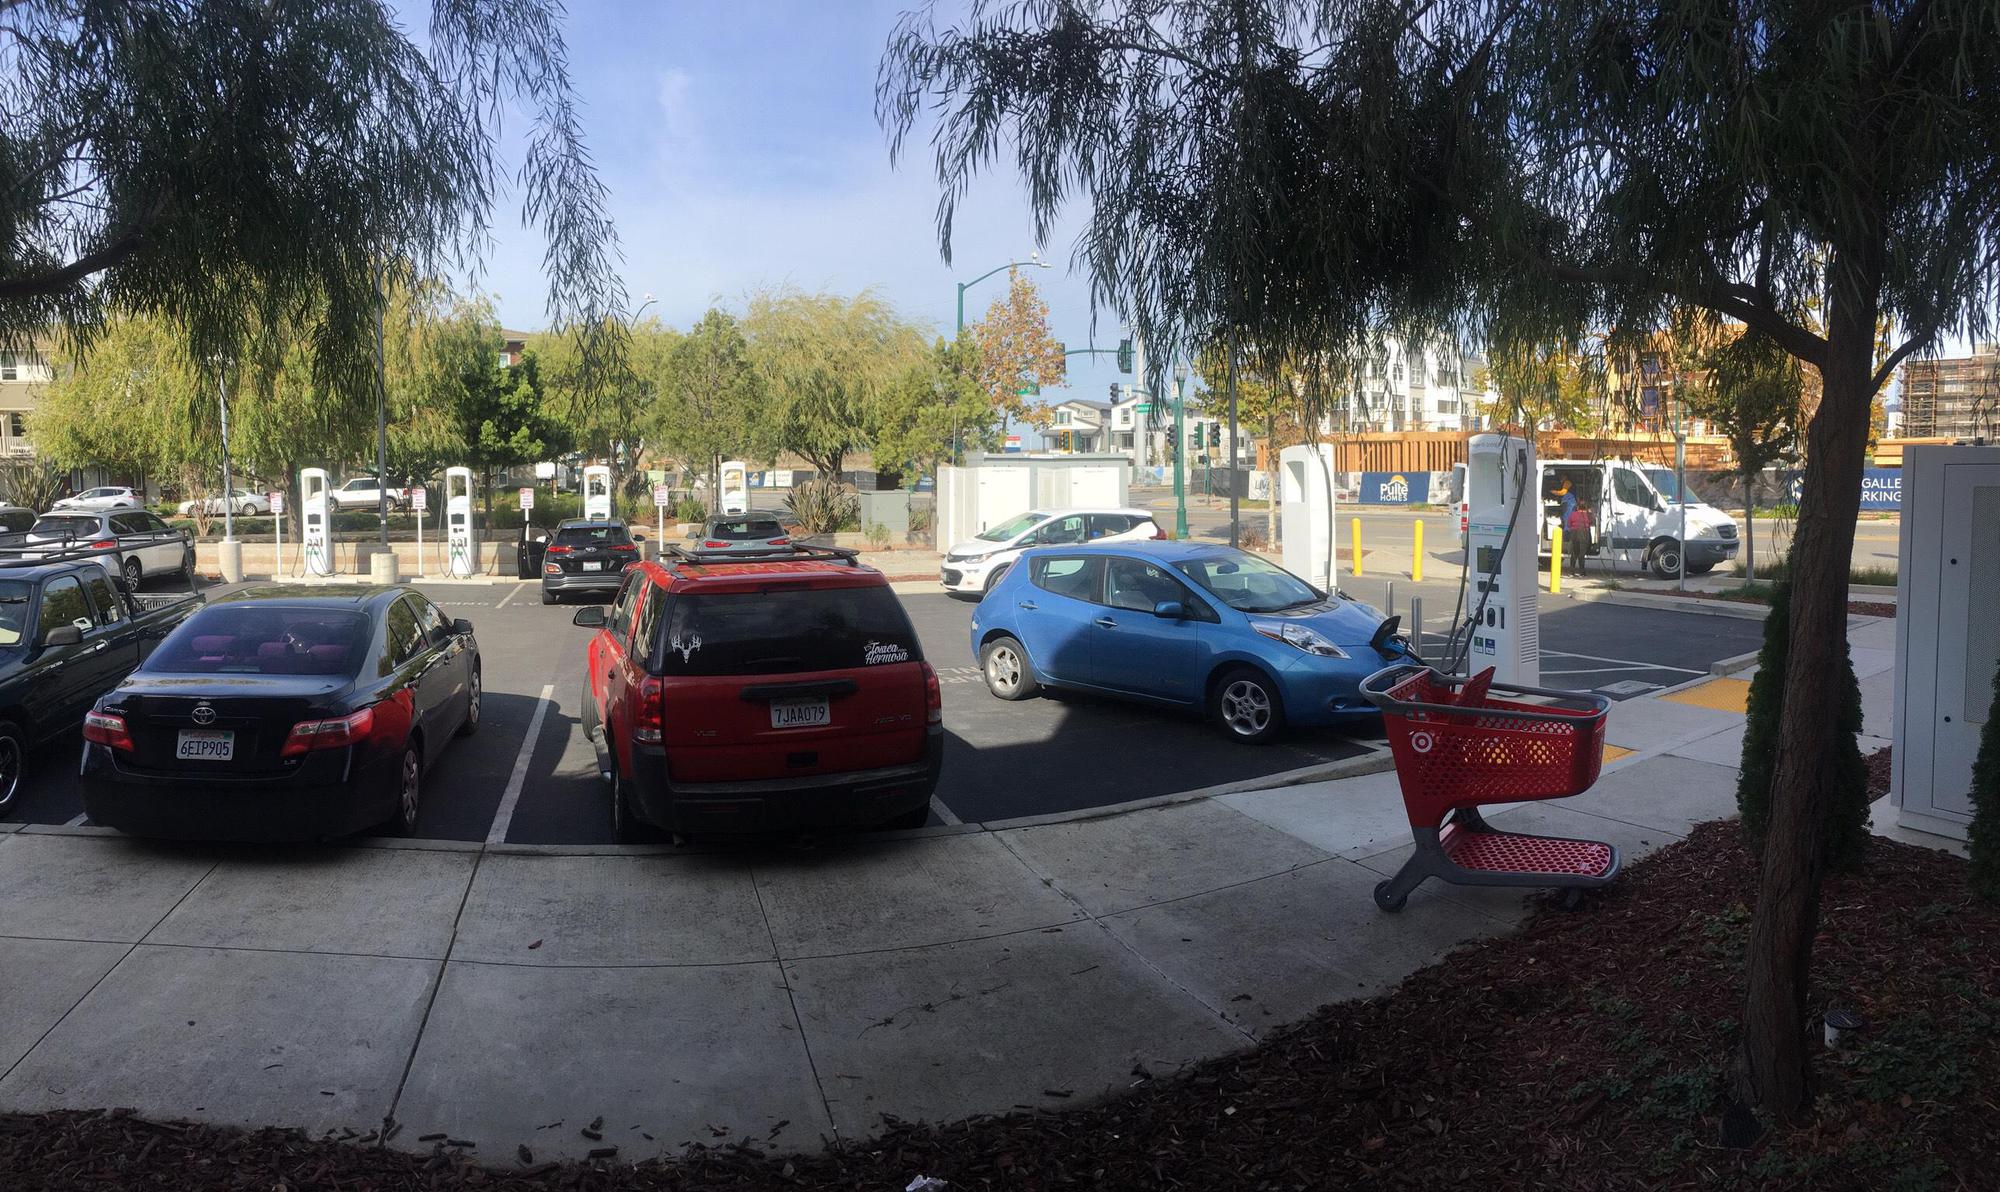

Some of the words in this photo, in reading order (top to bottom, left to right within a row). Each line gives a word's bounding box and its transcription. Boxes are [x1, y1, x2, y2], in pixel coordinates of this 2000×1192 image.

[1380, 483, 1408, 496] Pulte
[1380, 494, 1408, 502] HOMES
[1859, 491, 1902, 502] RKING
[865, 651, 909, 665] Hermosa
[775, 706, 825, 723] 7JAA079
[180, 740, 230, 756] 6EIP905
